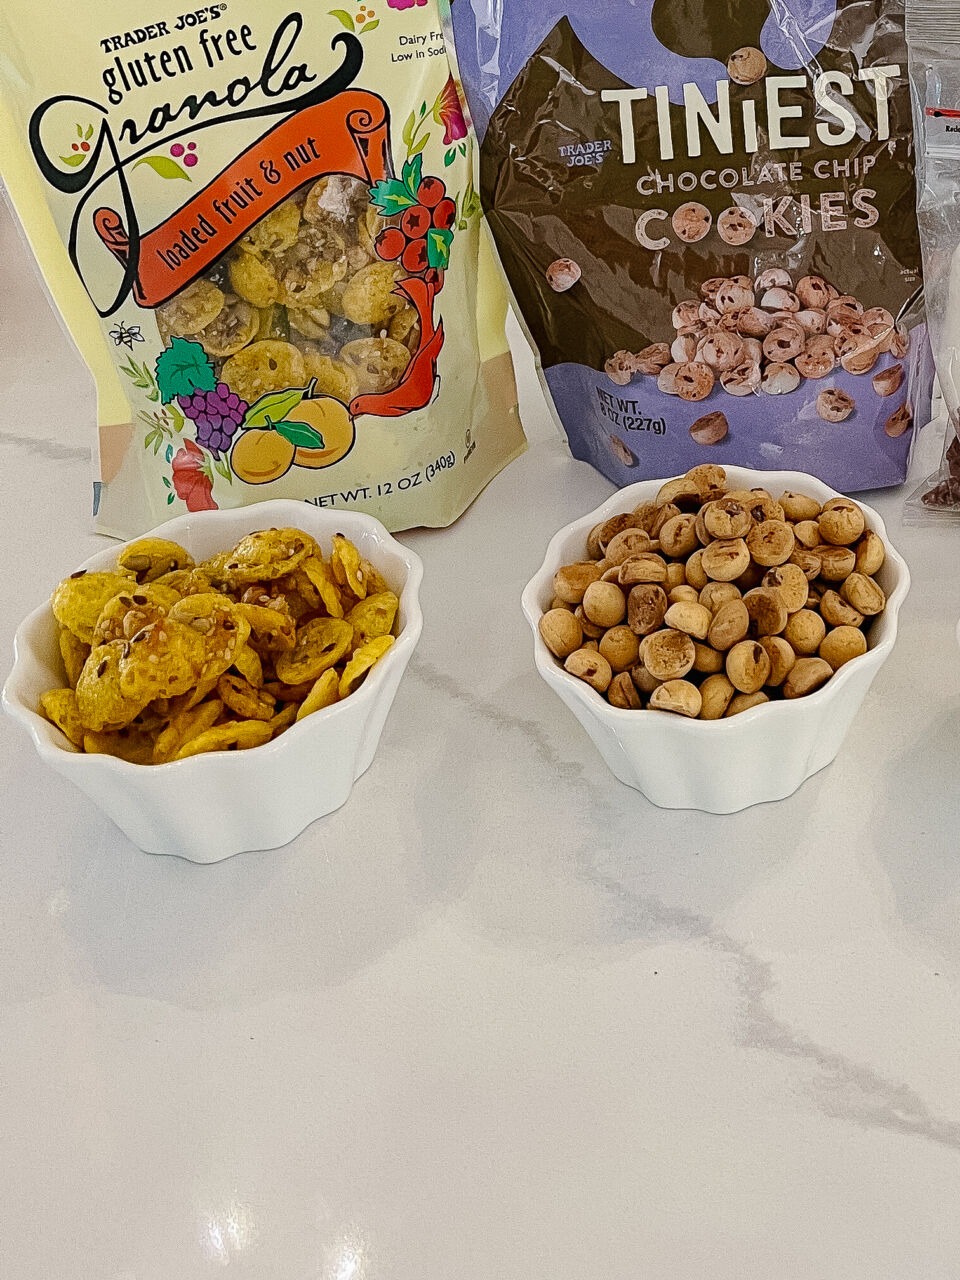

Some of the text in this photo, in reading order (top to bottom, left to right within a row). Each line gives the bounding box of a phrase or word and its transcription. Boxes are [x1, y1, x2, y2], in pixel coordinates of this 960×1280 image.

[100, 21, 171, 53] TRADER
[399, 31, 444, 46] Dairy Fre
[102, 24, 257, 105] gluten free
[391, 53, 413, 62] Low
[558, 139, 612, 157] TRADER
[566, 151, 604, 168] JOE'S
[29, 11, 363, 318] Granola
[635, 154, 877, 196] CHOCOLATE CHIP
[156, 137, 321, 271] loaded fruit & nut
[634, 187, 880, 251] COOKIES
[616, 397, 642, 416] WT.
[622, 415, 667, 436] (227g)
[340, 487, 372, 503] WT.
[377, 482, 393, 497] 12
[398, 472, 423, 491] OZ
[425, 450, 456, 483] (340g)
